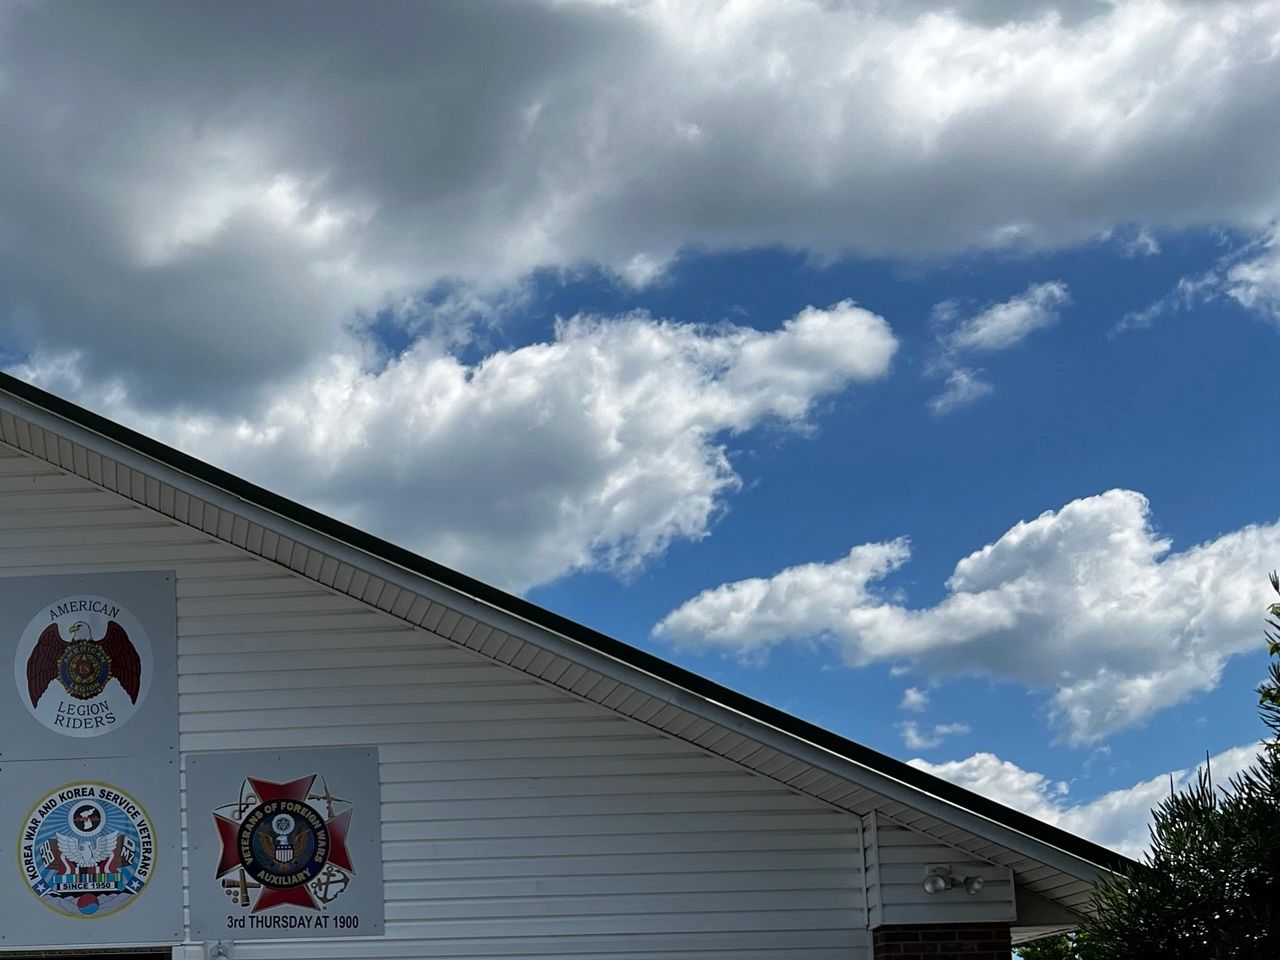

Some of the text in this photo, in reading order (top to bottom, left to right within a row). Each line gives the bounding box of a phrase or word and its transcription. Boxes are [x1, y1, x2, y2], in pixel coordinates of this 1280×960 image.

[49, 600, 120, 620] AMERICAN
[58, 700, 110, 716] LEGION
[54, 712, 116, 729] RIDERS
[24, 788, 152, 880] KOREA WAR AND KOREA SERVICE VETERANS
[241, 802, 326, 865] VETERANS OF FOREIGN WARS
[257, 868, 312, 885] AUXILIARY
[227, 915, 359, 929] 3rd THURSDAY AT 1900
